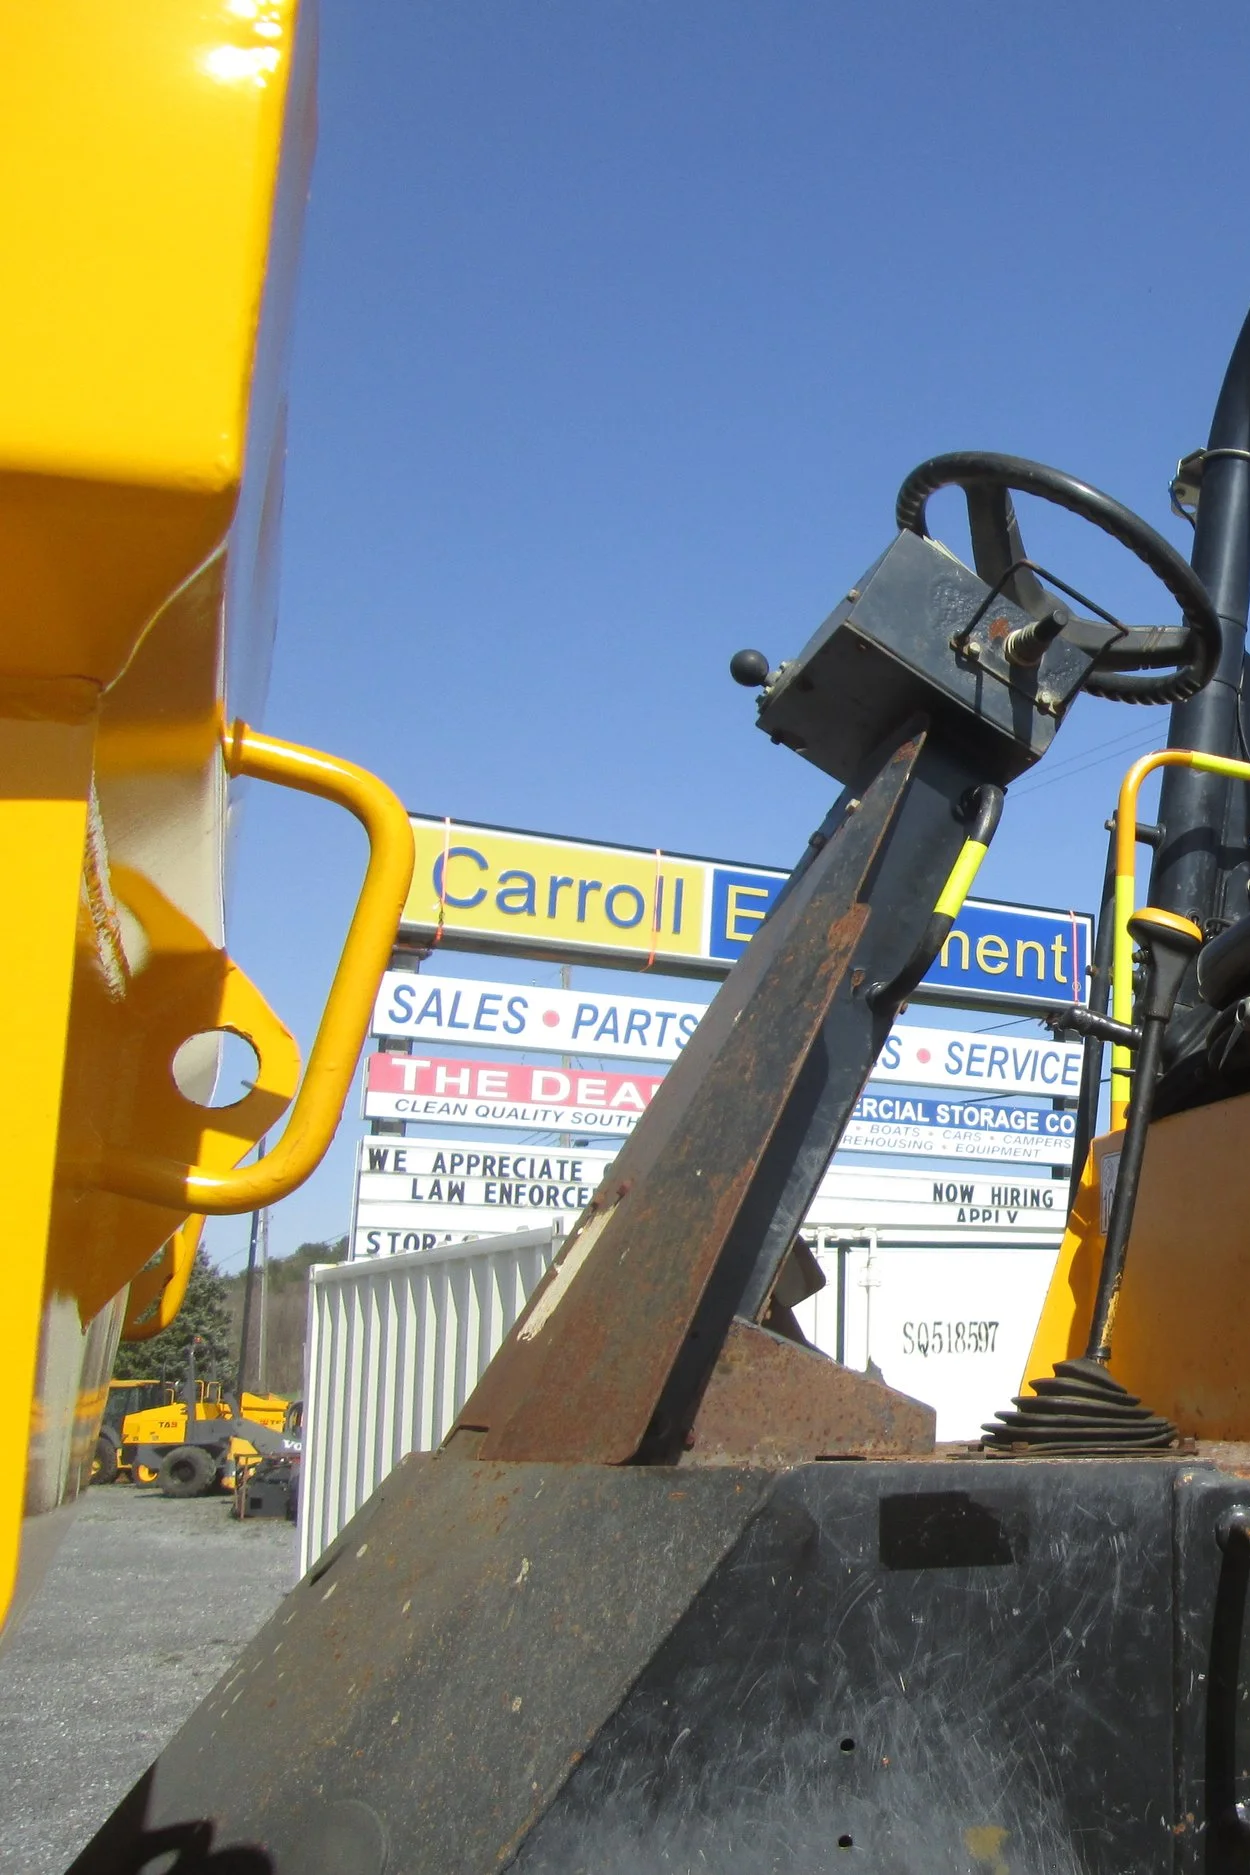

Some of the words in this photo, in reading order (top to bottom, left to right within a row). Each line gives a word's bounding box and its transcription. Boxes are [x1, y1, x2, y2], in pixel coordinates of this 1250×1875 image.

[432, 846, 684, 935] Carroll
[388, 985, 529, 1034] SALES
[571, 1003, 698, 1049] PARTS
[944, 1040, 1081, 1085] SERVICE
[391, 1058, 509, 1099] THE
[395, 1098, 467, 1117] CLEAN
[475, 1105, 565, 1124] QUALITY
[936, 1104, 1039, 1131] STORAGE
[870, 1124, 920, 1137] BOATS
[942, 1129, 982, 1142] CARS
[1003, 1135, 1072, 1149] CAMPERS
[955, 1143, 1041, 1158] EQUIPMENT
[369, 1148, 407, 1173] WE
[432, 1152, 583, 1182] APPRECIATE
[411, 1178, 465, 1206] LAW
[484, 1182, 598, 1209] ENFORCE
[933, 1183, 975, 1204] NOW
[991, 1186, 1054, 1209] HIRING
[903, 1321, 999, 1357] SQ518597
